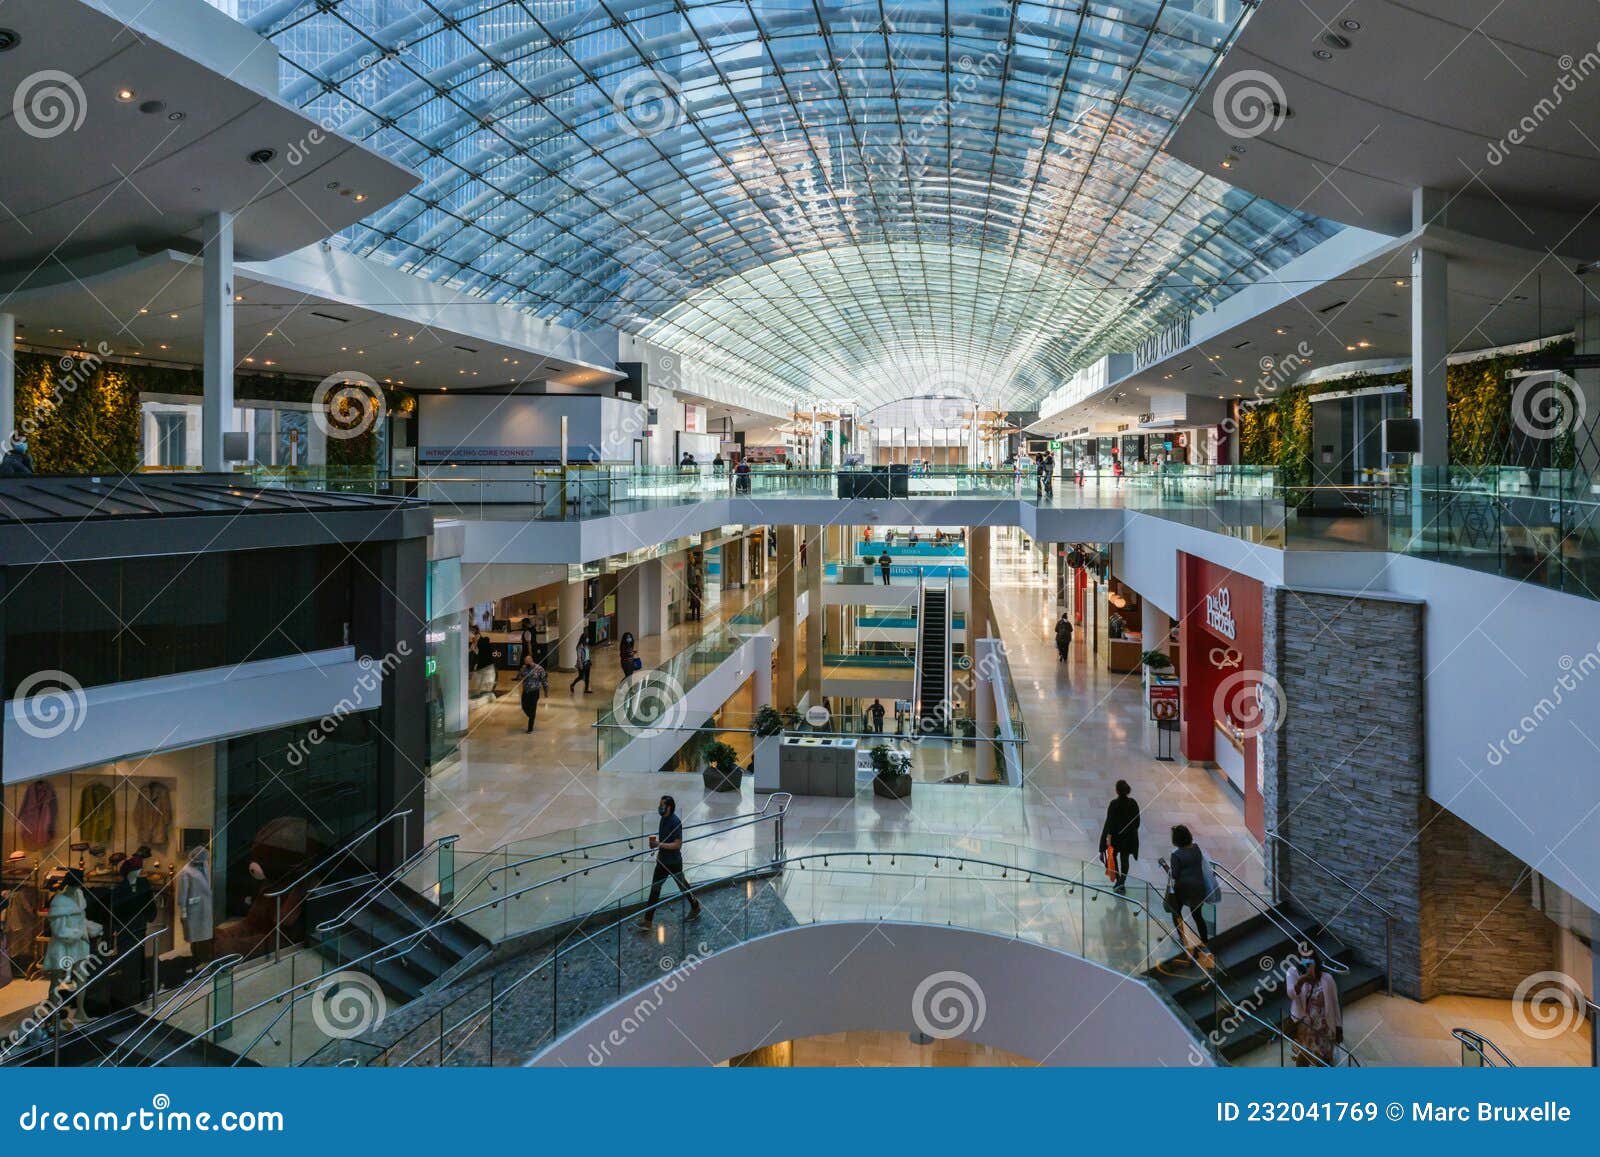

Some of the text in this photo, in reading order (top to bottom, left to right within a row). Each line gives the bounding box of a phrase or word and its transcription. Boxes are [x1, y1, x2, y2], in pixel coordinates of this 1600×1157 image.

[1136, 333, 1159, 370] FOOD
[425, 449, 535, 457] INTRODUCING CORE CONNECT
